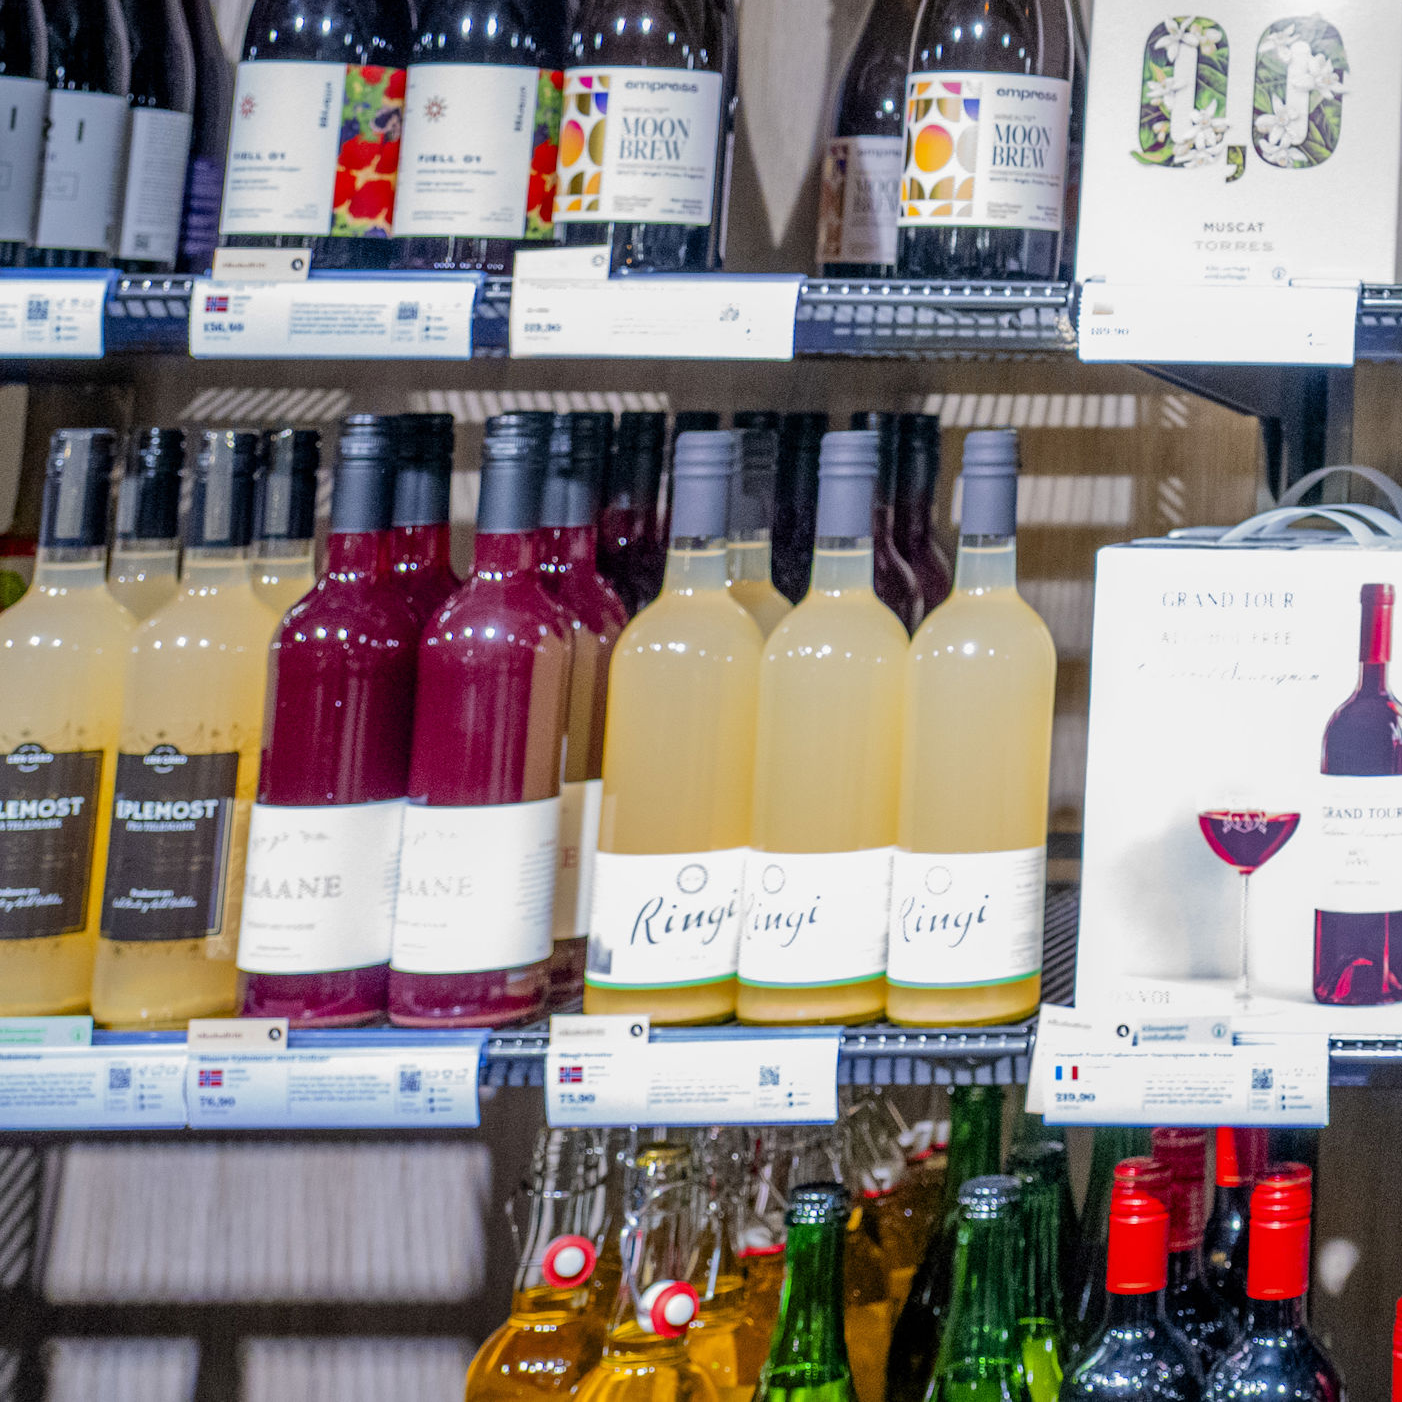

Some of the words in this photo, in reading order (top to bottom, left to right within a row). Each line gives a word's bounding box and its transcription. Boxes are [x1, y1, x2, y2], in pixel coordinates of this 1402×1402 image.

[624, 79, 699, 94] empress
[995, 86, 1059, 102] empress
[621, 116, 691, 139] MOON
[993, 123, 1052, 148] MOON
[618, 137, 684, 161] BREW
[991, 146, 1048, 170] BREW
[1202, 222, 1265, 233] MUSCAT
[1193, 240, 1275, 252] TORRES
[629, 888, 741, 947] Ringi
